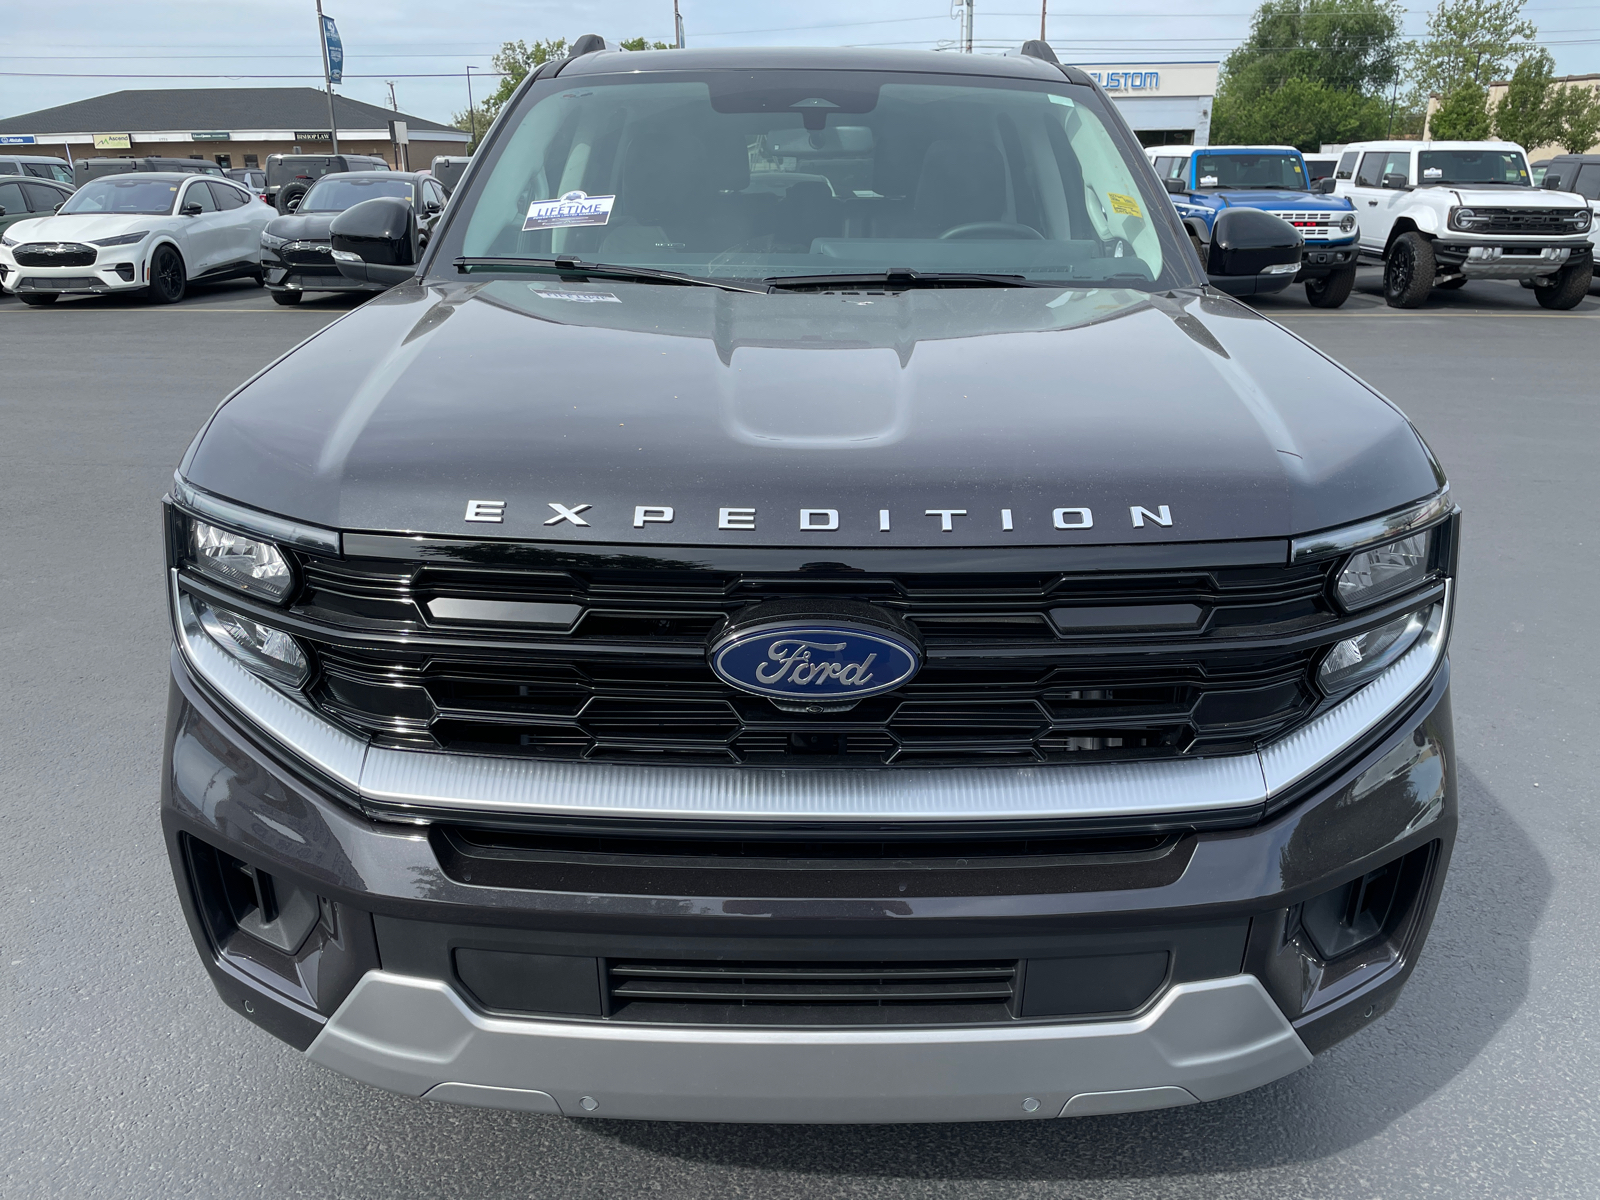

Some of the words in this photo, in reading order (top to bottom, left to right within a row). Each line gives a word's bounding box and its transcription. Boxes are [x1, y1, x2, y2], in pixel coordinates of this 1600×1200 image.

[537, 203, 602, 216] LIFETIME
[465, 499, 1173, 531] EXPEDITION
[755, 639, 878, 686] Ford
